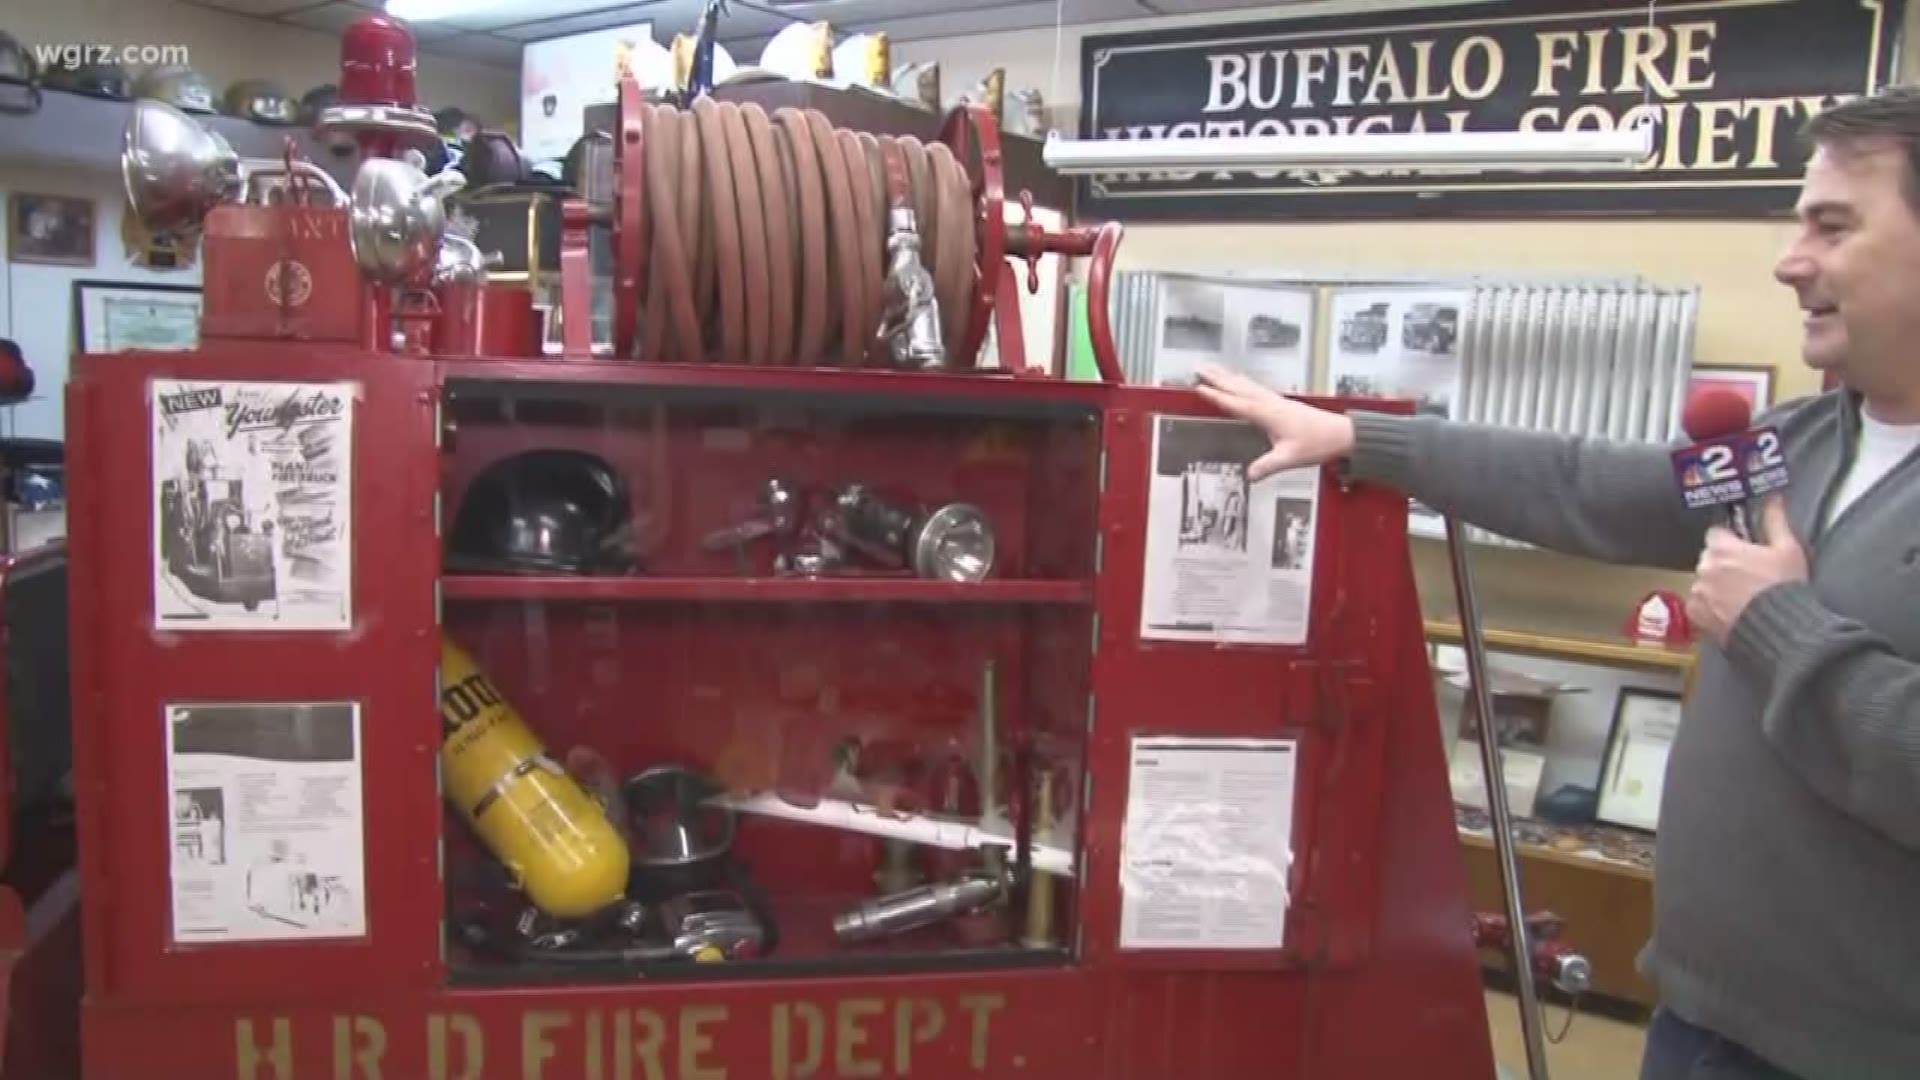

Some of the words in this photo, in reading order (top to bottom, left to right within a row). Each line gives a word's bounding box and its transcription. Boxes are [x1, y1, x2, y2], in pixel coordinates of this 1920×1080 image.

[1203, 36, 1504, 113] BUFFALO
[1531, 21, 1716, 97] FIRE
[166, 391, 222, 413] NEW
[225, 390, 343, 439] Youster
[1701, 445, 1739, 480] 2
[1756, 431, 1783, 465] 2
[236, 1017, 293, 1080] H
[333, 1014, 386, 1080] R
[521, 1004, 730, 1080] FIRE
[771, 992, 1026, 1080] DEPT.
